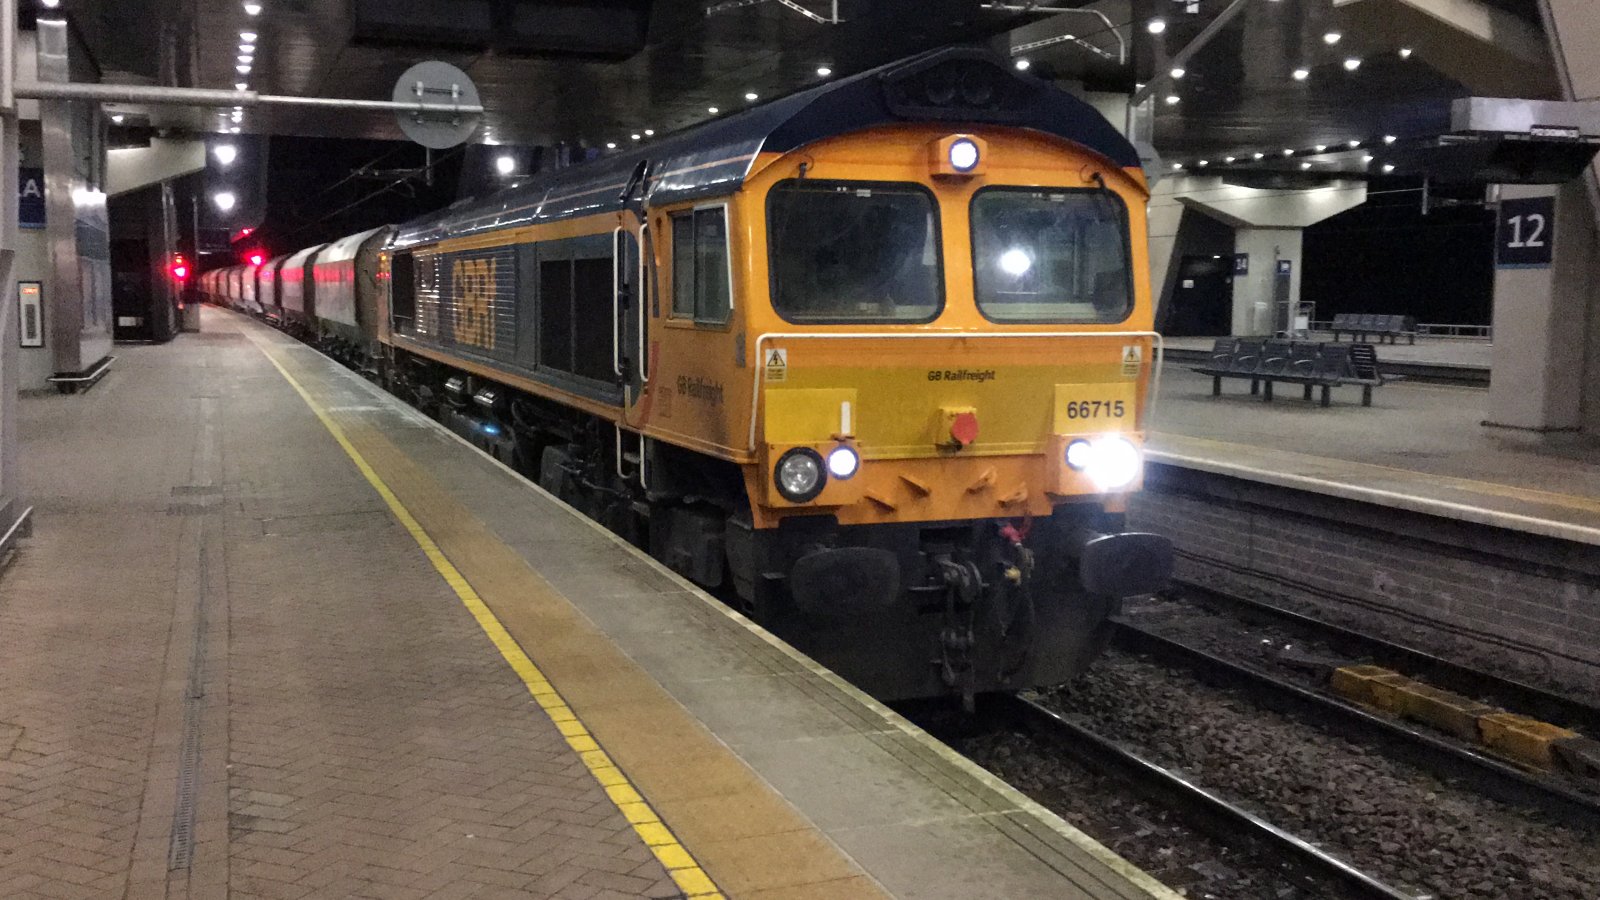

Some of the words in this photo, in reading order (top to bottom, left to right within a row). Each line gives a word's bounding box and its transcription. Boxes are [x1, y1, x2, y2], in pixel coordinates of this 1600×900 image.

[19, 178, 41, 198] A
[1507, 213, 1546, 248] 12
[927, 370, 942, 381] GB
[943, 369, 996, 383] Railfreight
[1067, 400, 1125, 419] 66715
